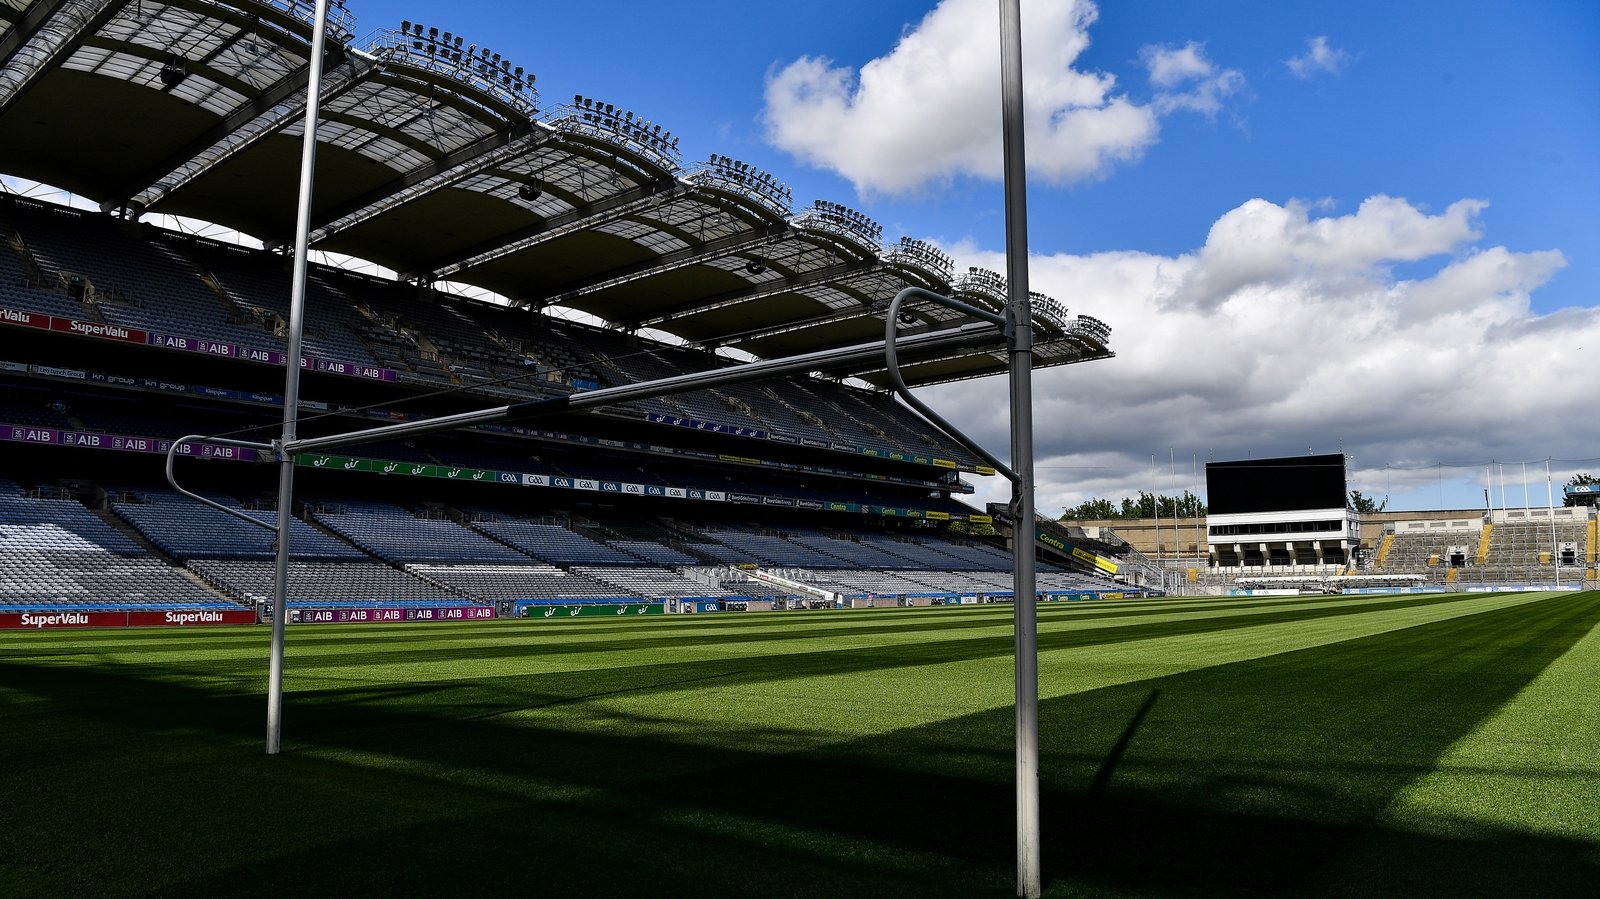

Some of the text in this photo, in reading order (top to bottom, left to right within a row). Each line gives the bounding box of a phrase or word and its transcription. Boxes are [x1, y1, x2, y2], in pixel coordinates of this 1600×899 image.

[71, 320, 129, 339] SuperValu
[166, 337, 187, 349] AIB
[209, 344, 229, 355] AIB
[250, 350, 269, 361] AIB
[328, 362, 345, 373] AIB
[363, 368, 379, 378] AIB
[108, 376, 134, 385] group
[160, 382, 186, 391] group
[27, 430, 50, 441] AIB
[78, 435, 100, 446] AIB
[125, 439, 146, 450] AIB
[213, 447, 233, 458] AIB
[1040, 533, 1064, 550] Centra
[447, 609, 462, 618] AIB
[476, 608, 491, 618] AIB
[705, 604, 718, 612] GAA
[166, 611, 223, 625] SuperValu
[314, 612, 332, 621] AIB
[350, 611, 367, 620] AIB
[384, 610, 400, 620] AIB
[416, 610, 432, 619] AIB
[21, 613, 88, 628] SuperValu
